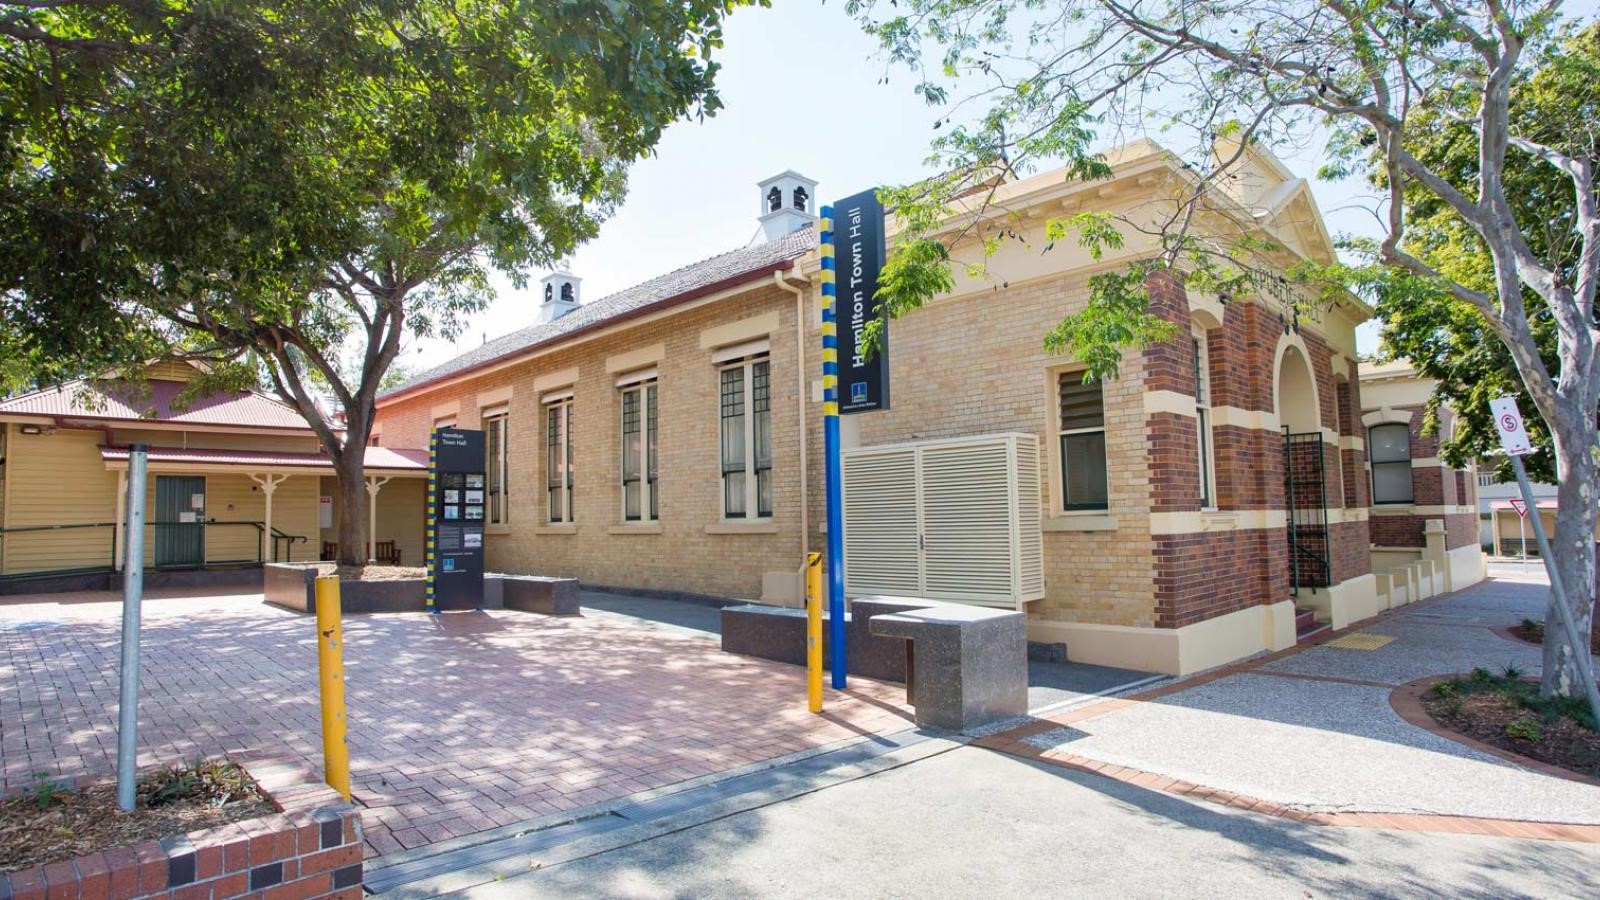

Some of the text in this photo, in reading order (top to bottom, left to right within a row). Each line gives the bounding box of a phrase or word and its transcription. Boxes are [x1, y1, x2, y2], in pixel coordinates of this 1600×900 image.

[848, 207, 865, 368] Hamilton Town Hall
